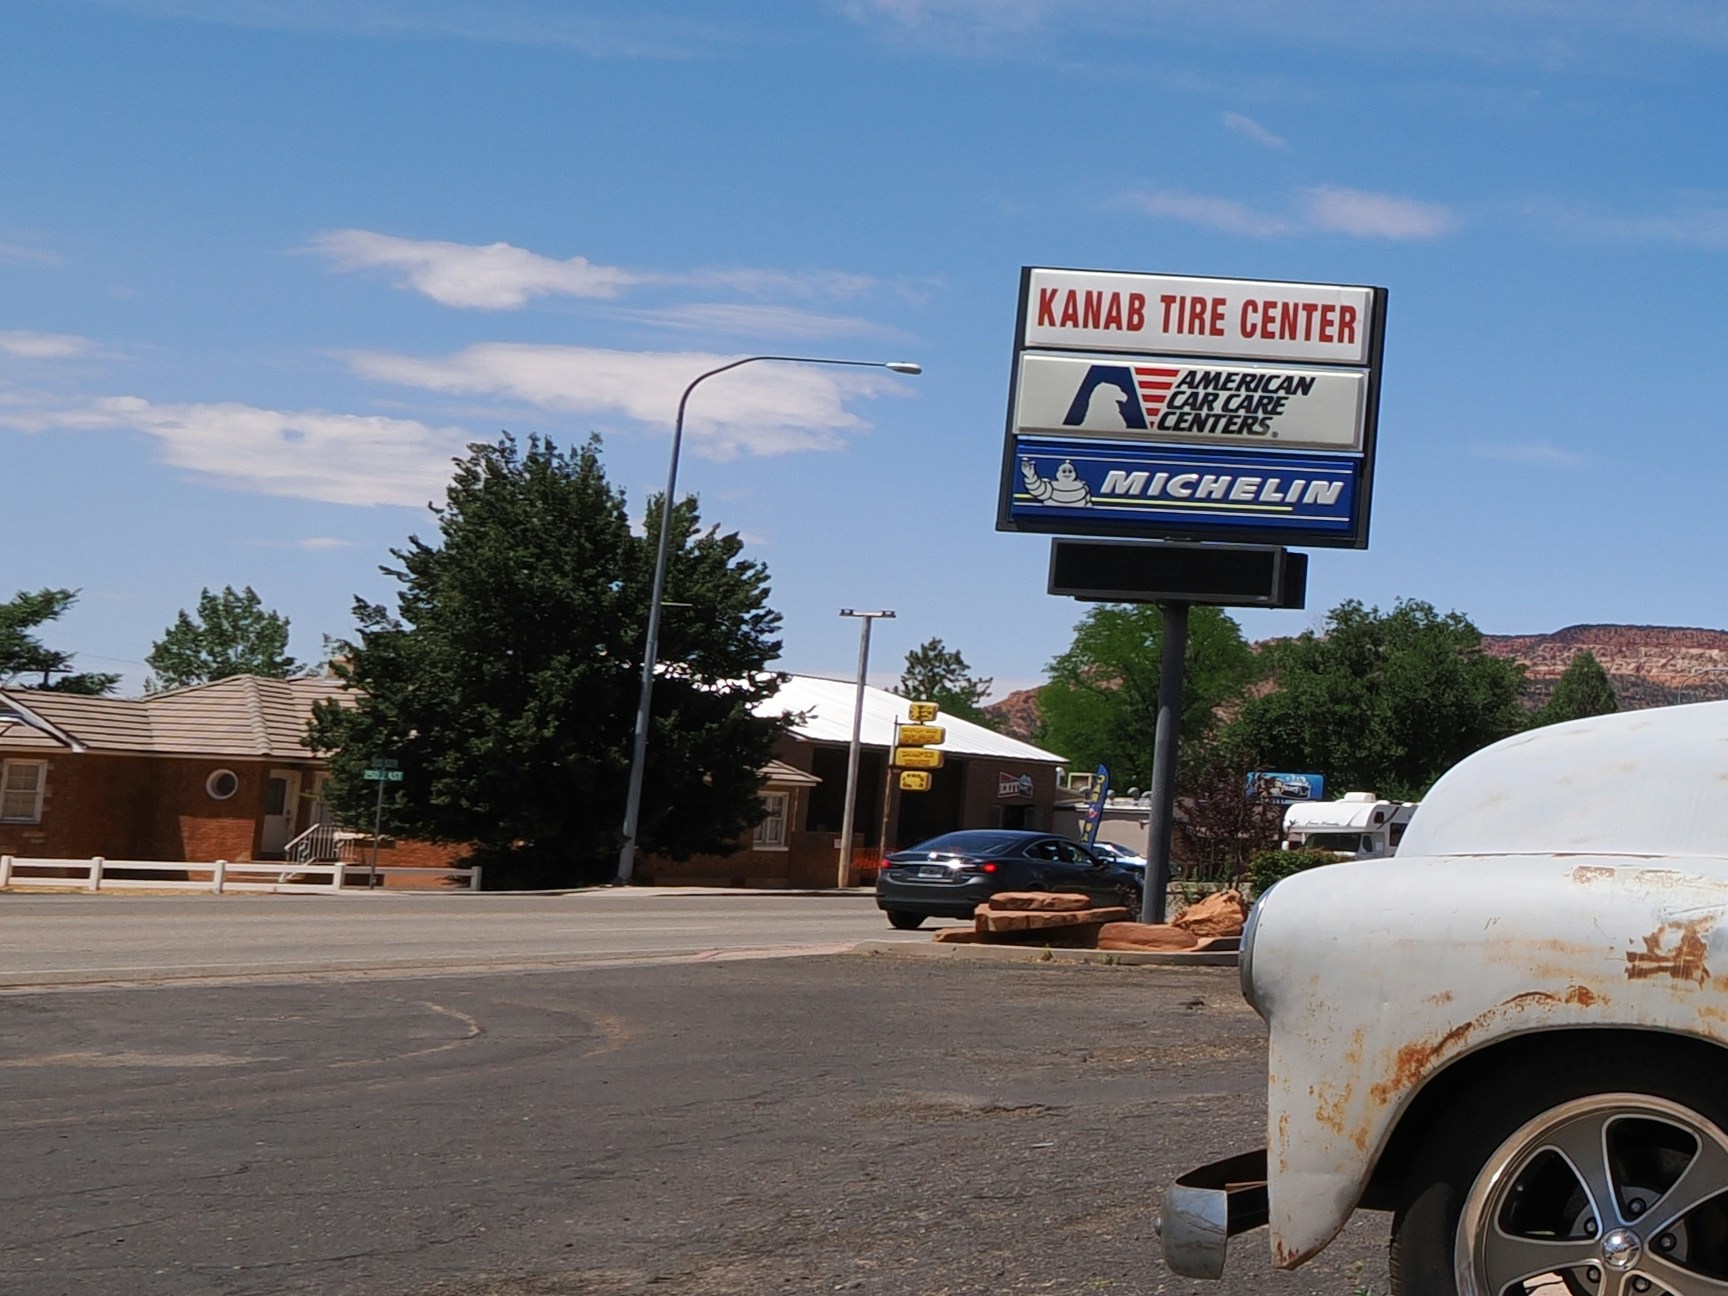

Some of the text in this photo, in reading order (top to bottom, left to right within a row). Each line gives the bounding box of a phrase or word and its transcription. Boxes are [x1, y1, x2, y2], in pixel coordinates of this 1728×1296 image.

[1037, 287, 1358, 344] KANAB TIRE CENTER
[1174, 368, 1317, 396] AMERICAN
[1165, 390, 1289, 417] CAR CARE
[1156, 410, 1272, 436] CENTERS
[1100, 469, 1344, 505] MICHELIN
